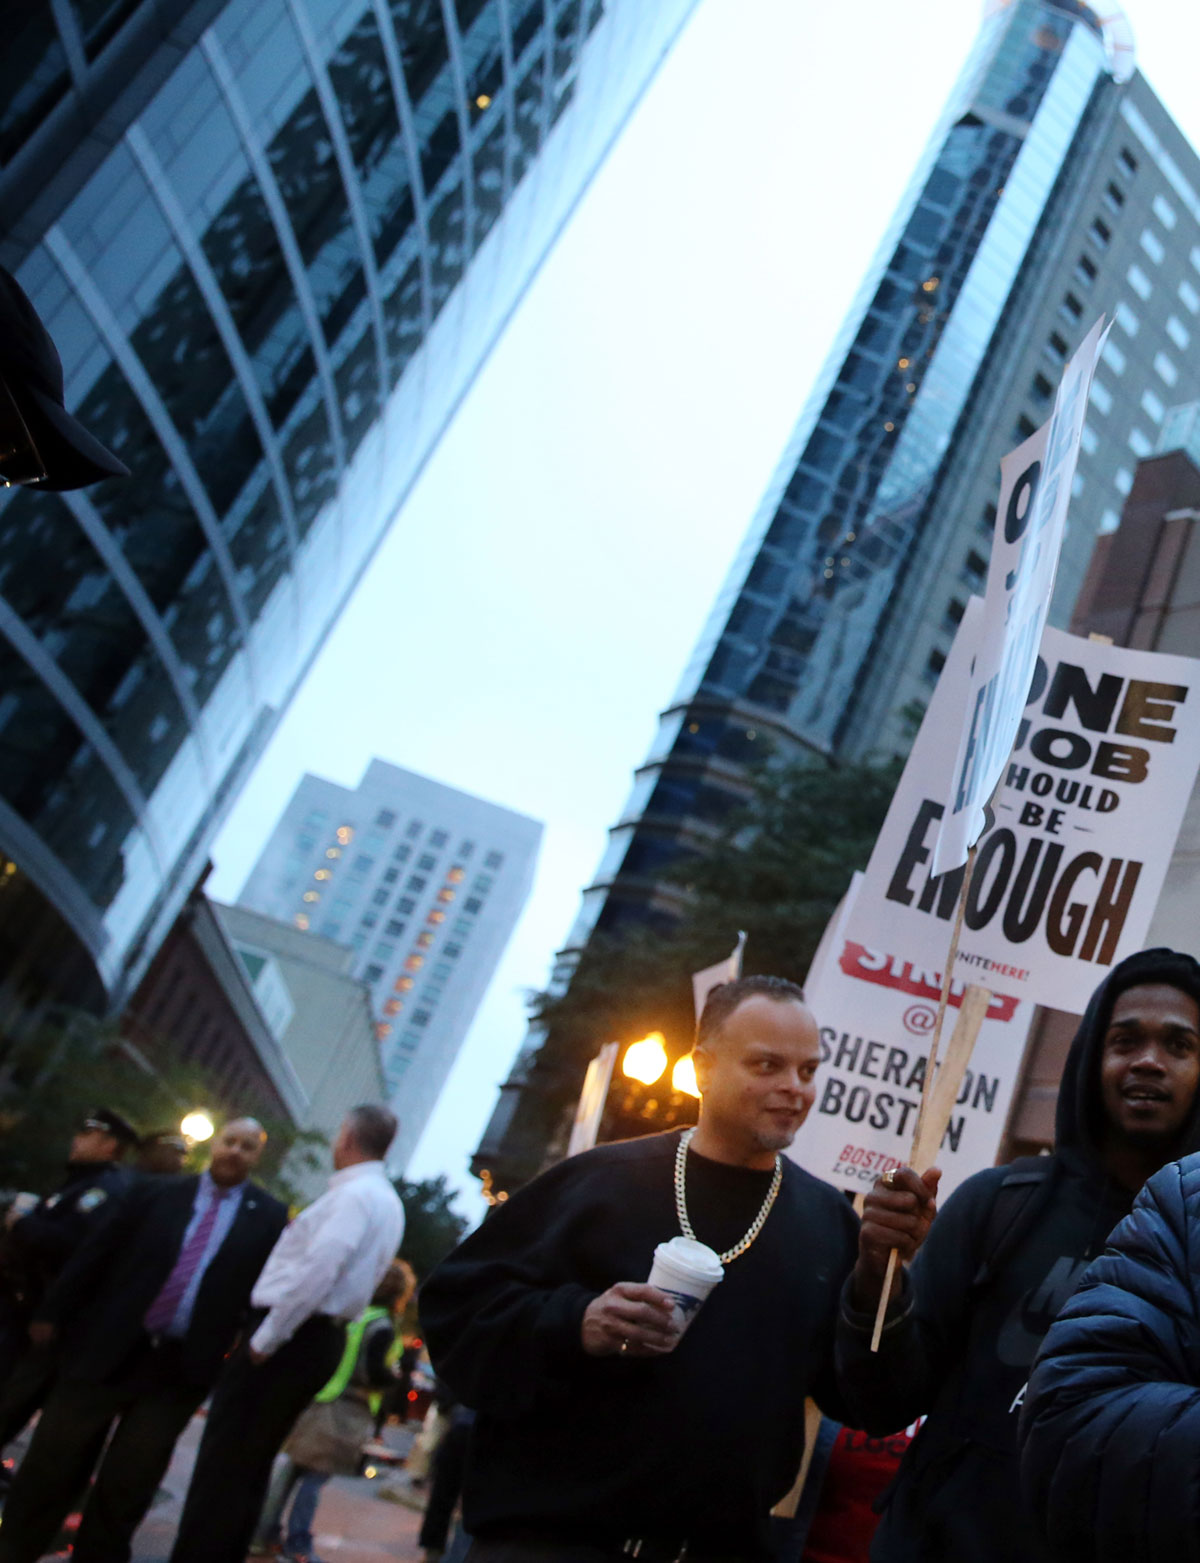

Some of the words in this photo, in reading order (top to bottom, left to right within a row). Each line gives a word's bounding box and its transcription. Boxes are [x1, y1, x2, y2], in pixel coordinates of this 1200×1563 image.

[1005, 763, 1120, 813] HOULD
[1019, 802, 1066, 834] BE
[903, 1004, 938, 1036] @
[819, 1026, 999, 1113] SHERAON
[818, 1077, 965, 1152] BOSTN
